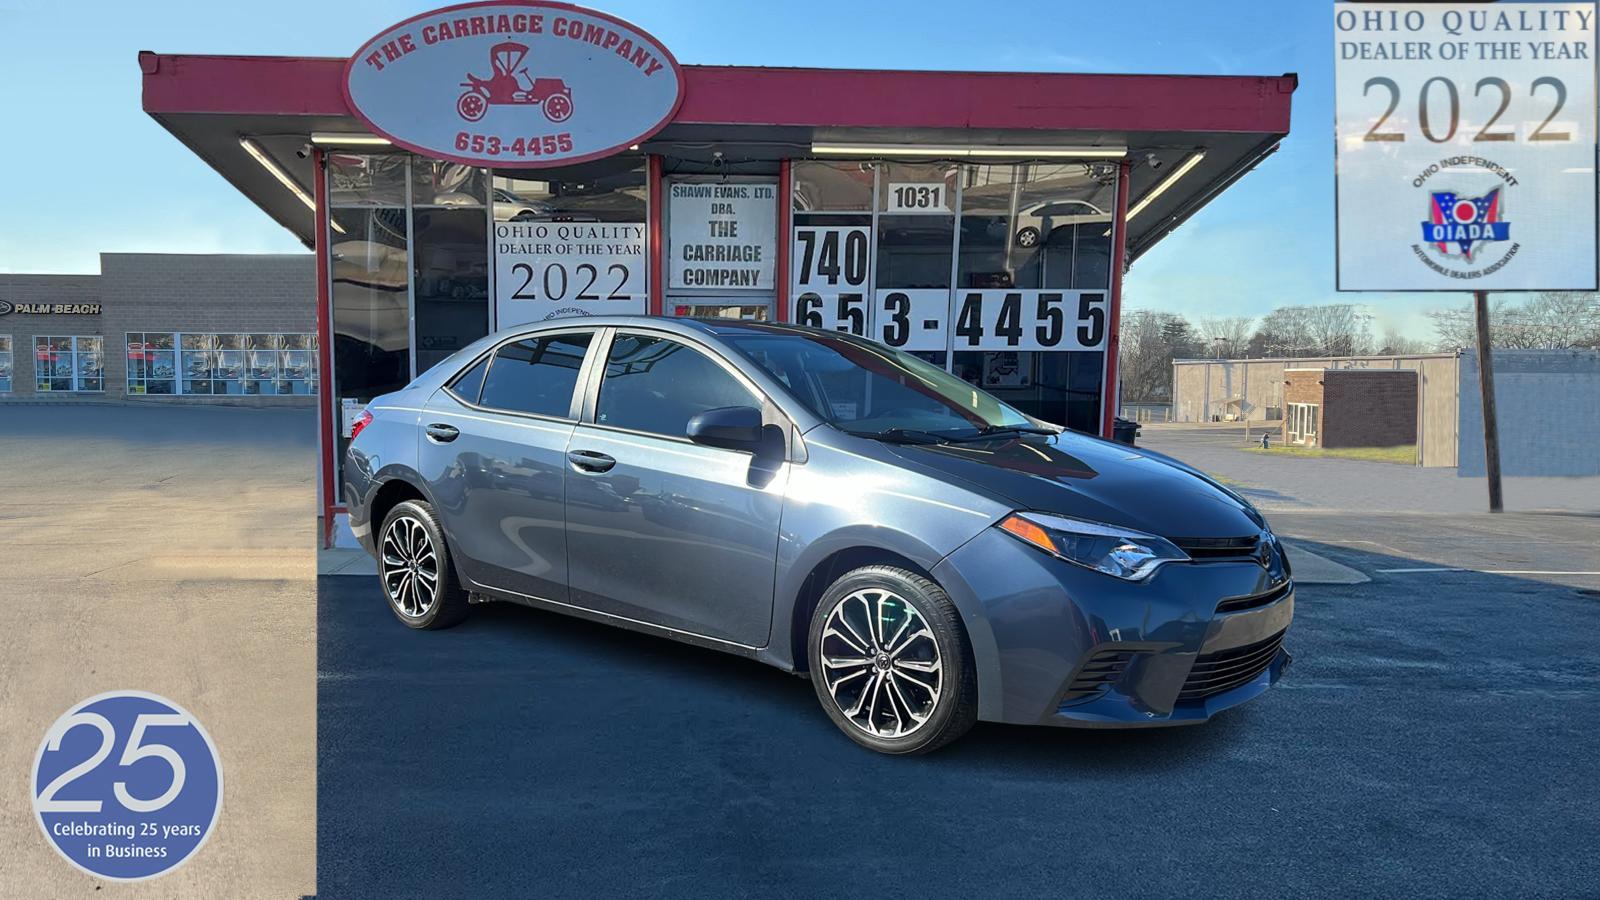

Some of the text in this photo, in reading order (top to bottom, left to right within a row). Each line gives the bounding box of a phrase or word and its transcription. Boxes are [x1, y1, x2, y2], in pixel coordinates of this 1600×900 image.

[1336, 10, 1593, 35] OHIO QUALITY
[366, 14, 664, 77] THE CARRIAGE COMPANY
[1340, 41, 1588, 60] DEALER OF THE YEAR
[1363, 76, 1571, 143] 2022
[455, 132, 573, 156] 653-4455
[1412, 155, 1519, 188] OHIO INDEPENDENT
[672, 185, 712, 199] SHAWN
[754, 186, 775, 200] LTD.
[894, 186, 940, 209] 1031
[711, 203, 736, 216] DBA.
[497, 226, 644, 242] OHIO QUALITY
[708, 220, 738, 238] THE
[1432, 224, 1495, 240] OIADA
[499, 243, 641, 256] DEALER OF THE YEAR
[683, 244, 762, 263] CARRIAGE
[797, 229, 868, 286] 740
[511, 263, 632, 301] 2022
[683, 268, 761, 287] COMPANY
[14, 303, 100, 314] PALM BEACH
